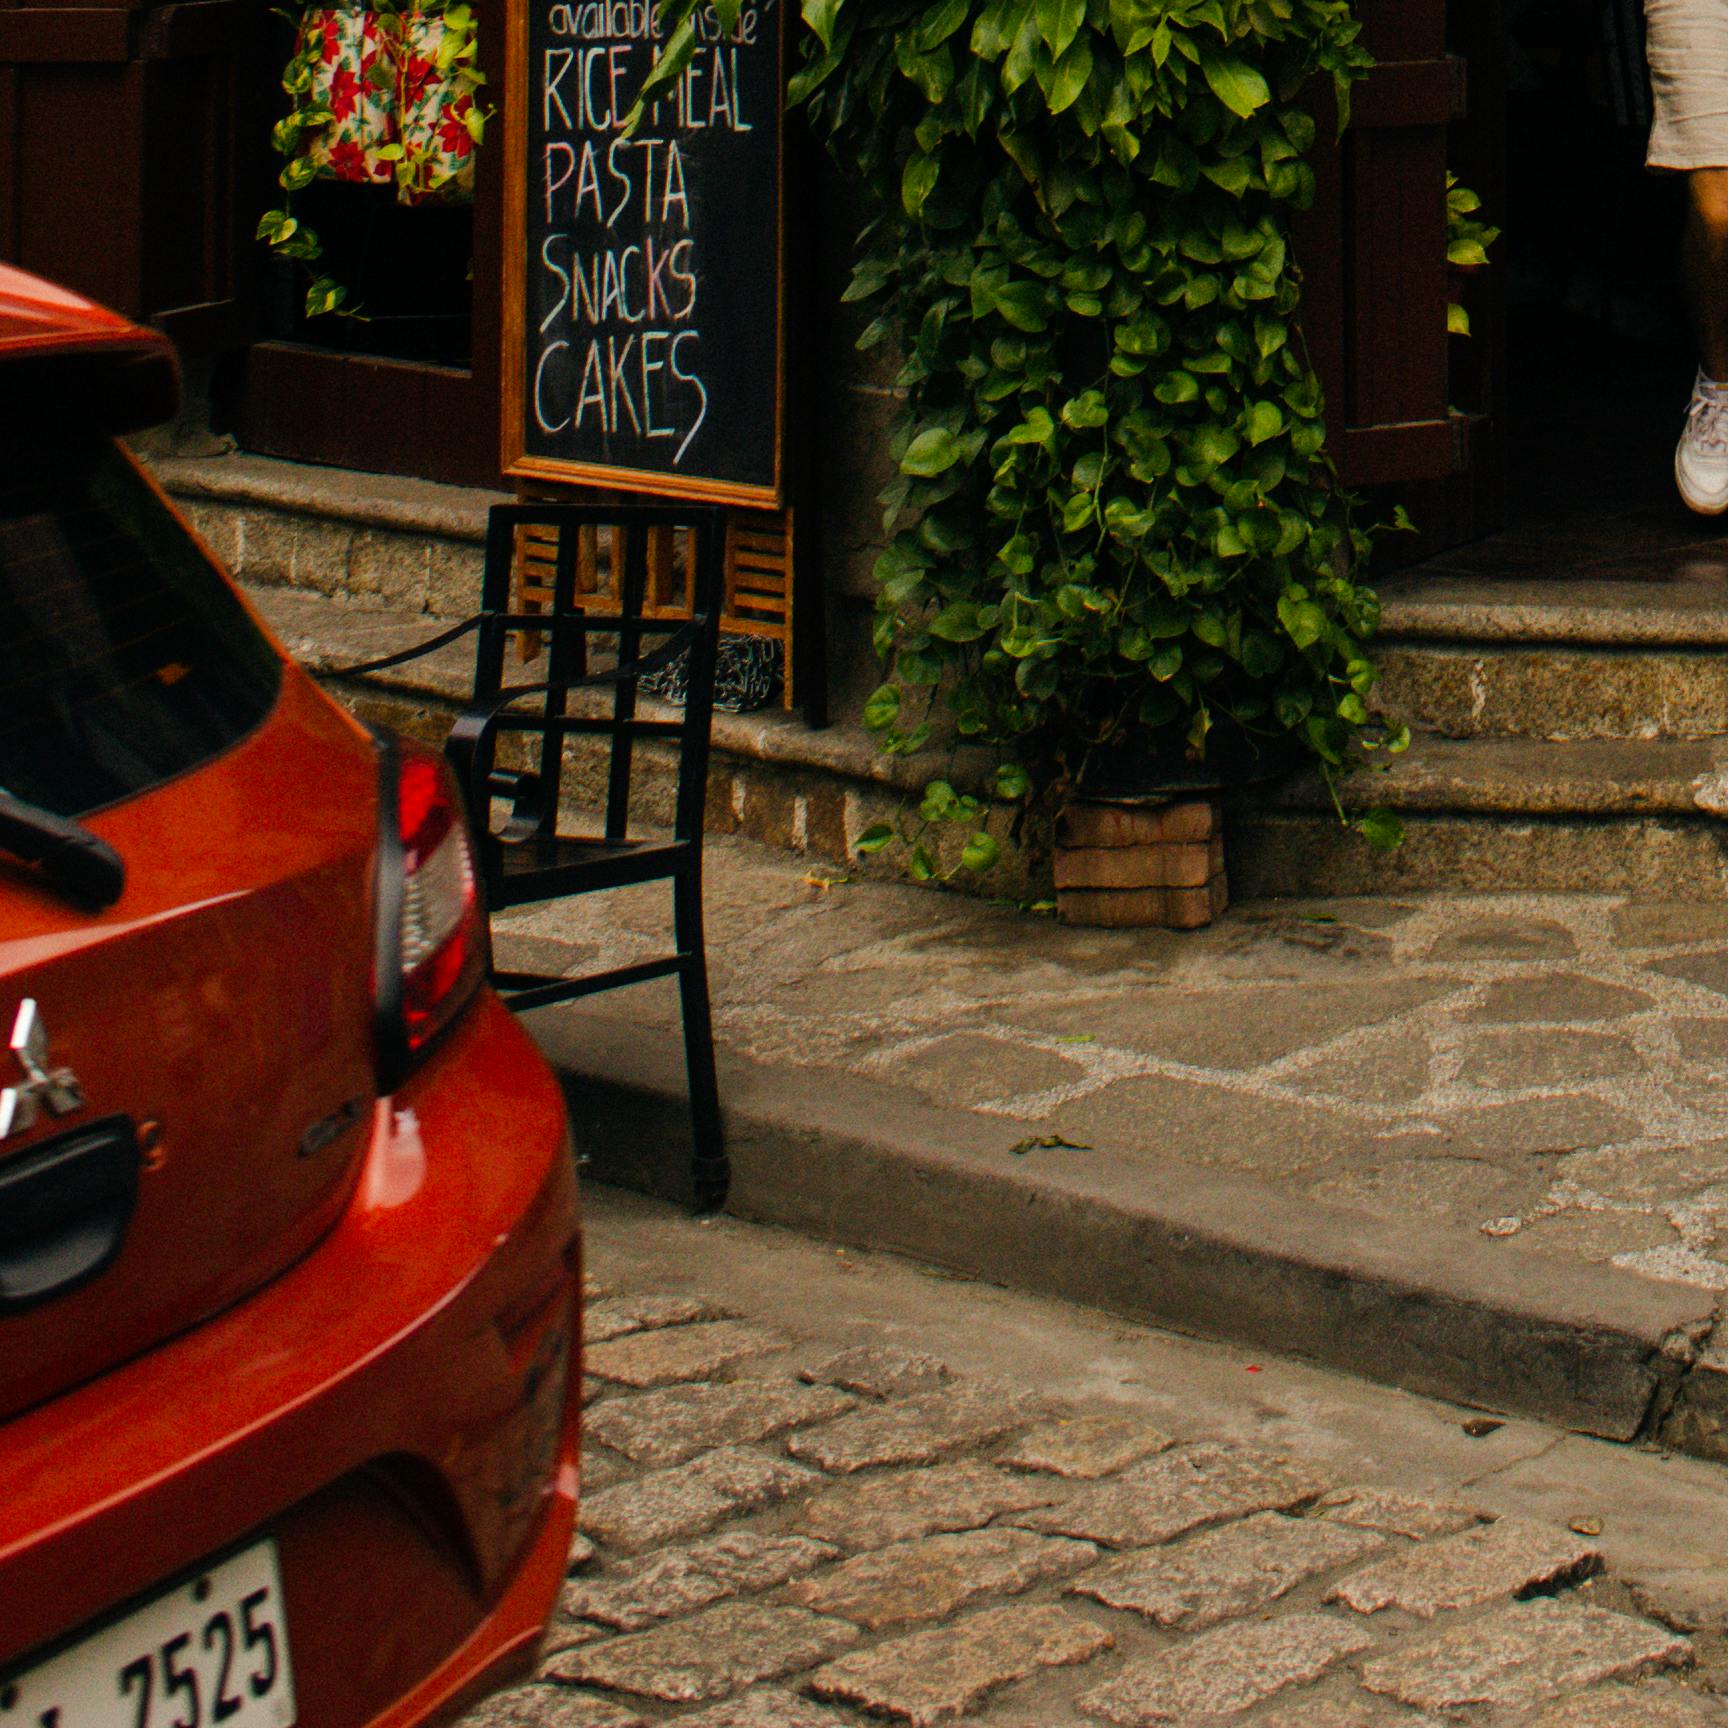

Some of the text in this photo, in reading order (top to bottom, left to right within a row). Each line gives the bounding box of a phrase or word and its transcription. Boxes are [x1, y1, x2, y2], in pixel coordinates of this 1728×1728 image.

[543, 45, 632, 132] RICE
[543, 138, 690, 230] PASTA
[539, 234, 697, 333] SNACKS
[533, 330, 707, 465] CAKES
[120, 1587, 277, 1728] 7525
